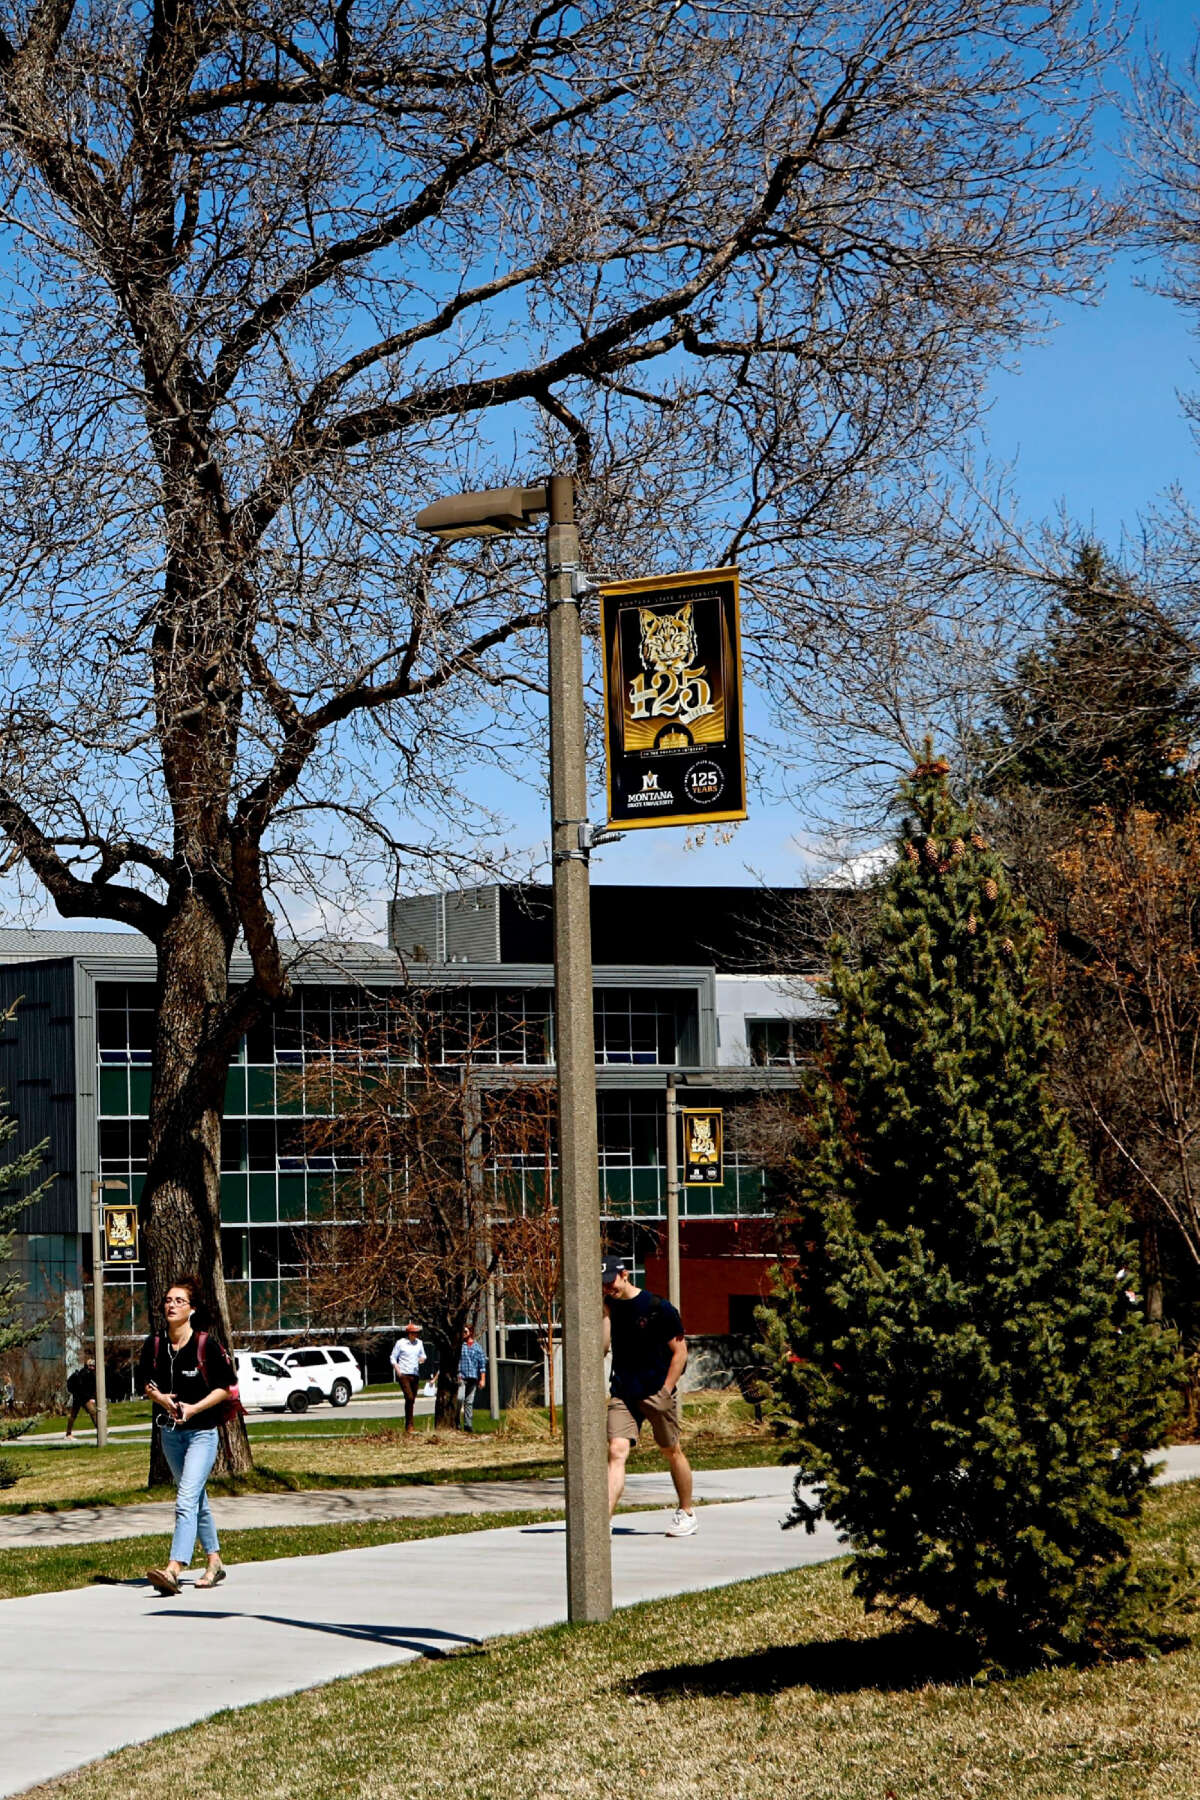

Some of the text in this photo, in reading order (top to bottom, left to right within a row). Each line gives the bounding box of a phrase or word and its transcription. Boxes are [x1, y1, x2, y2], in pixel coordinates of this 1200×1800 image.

[629, 666, 711, 719] 125
[691, 771, 718, 787] 125
[628, 790, 674, 802] MONTANA
[692, 785, 718, 793] YEARS
